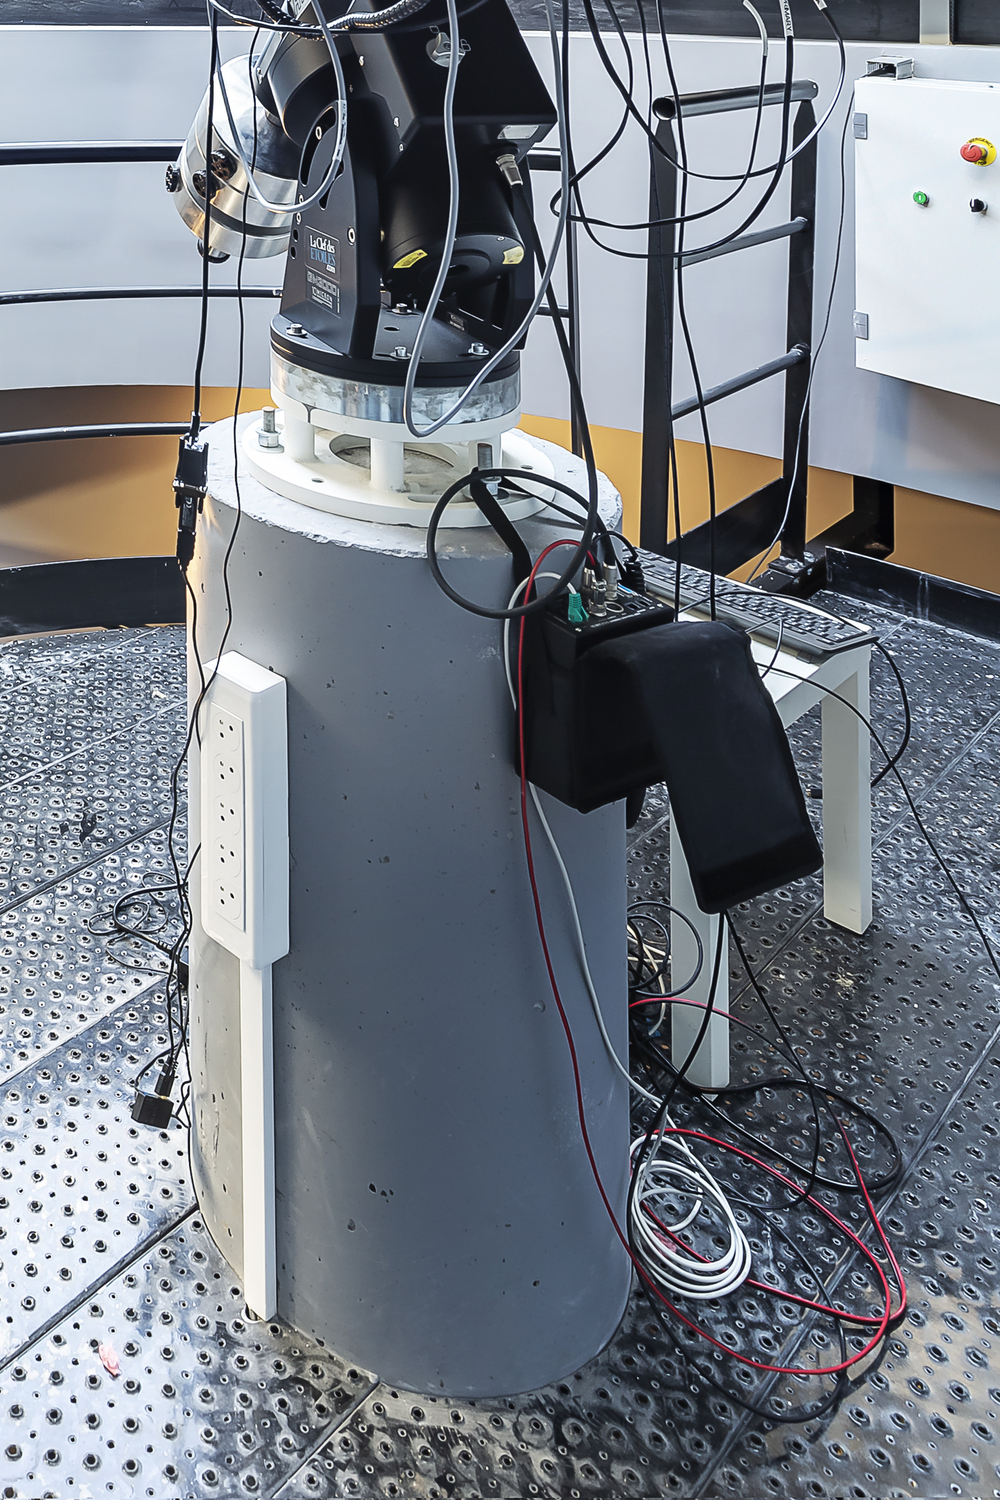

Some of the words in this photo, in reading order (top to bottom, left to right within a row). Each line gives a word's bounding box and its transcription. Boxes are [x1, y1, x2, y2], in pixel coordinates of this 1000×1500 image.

[309, 234, 317, 248] La
[316, 237, 328, 251] Clef
[327, 240, 335, 254] des
[310, 247, 336, 266] ETOILES
